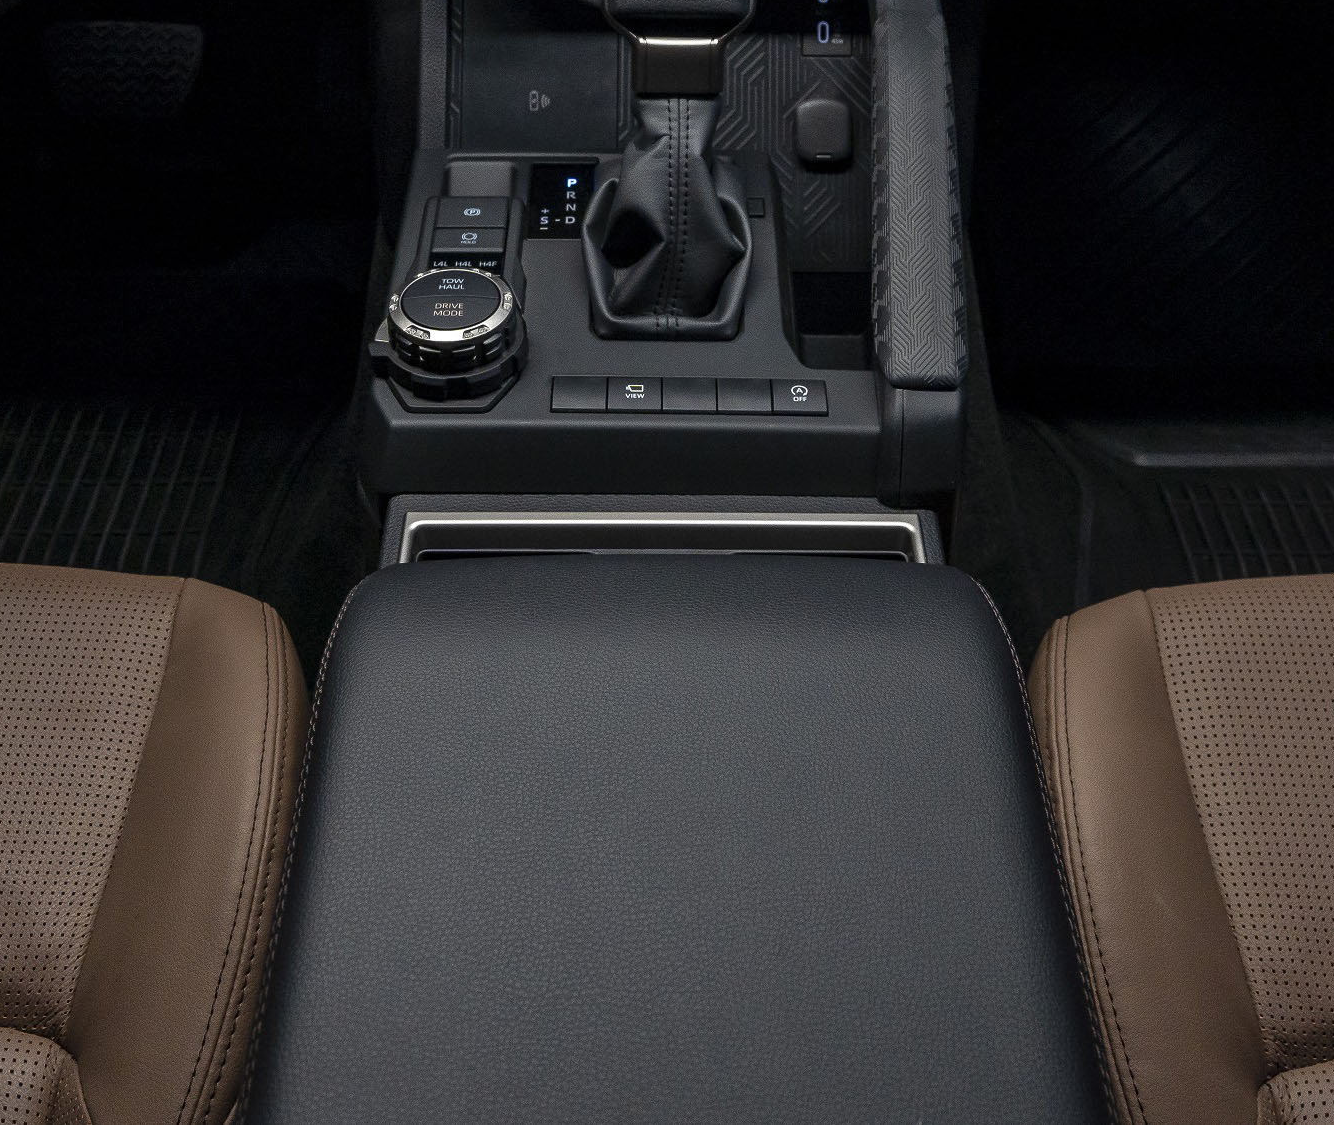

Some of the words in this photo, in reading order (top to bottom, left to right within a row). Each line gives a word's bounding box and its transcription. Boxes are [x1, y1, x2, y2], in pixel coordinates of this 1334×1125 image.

[567, 178, 577, 187] P
[567, 191, 576, 199] R
[566, 203, 576, 212] N
[540, 216, 549, 224] S
[565, 216, 576, 224] D
[434, 302, 464, 310] DRIVE
